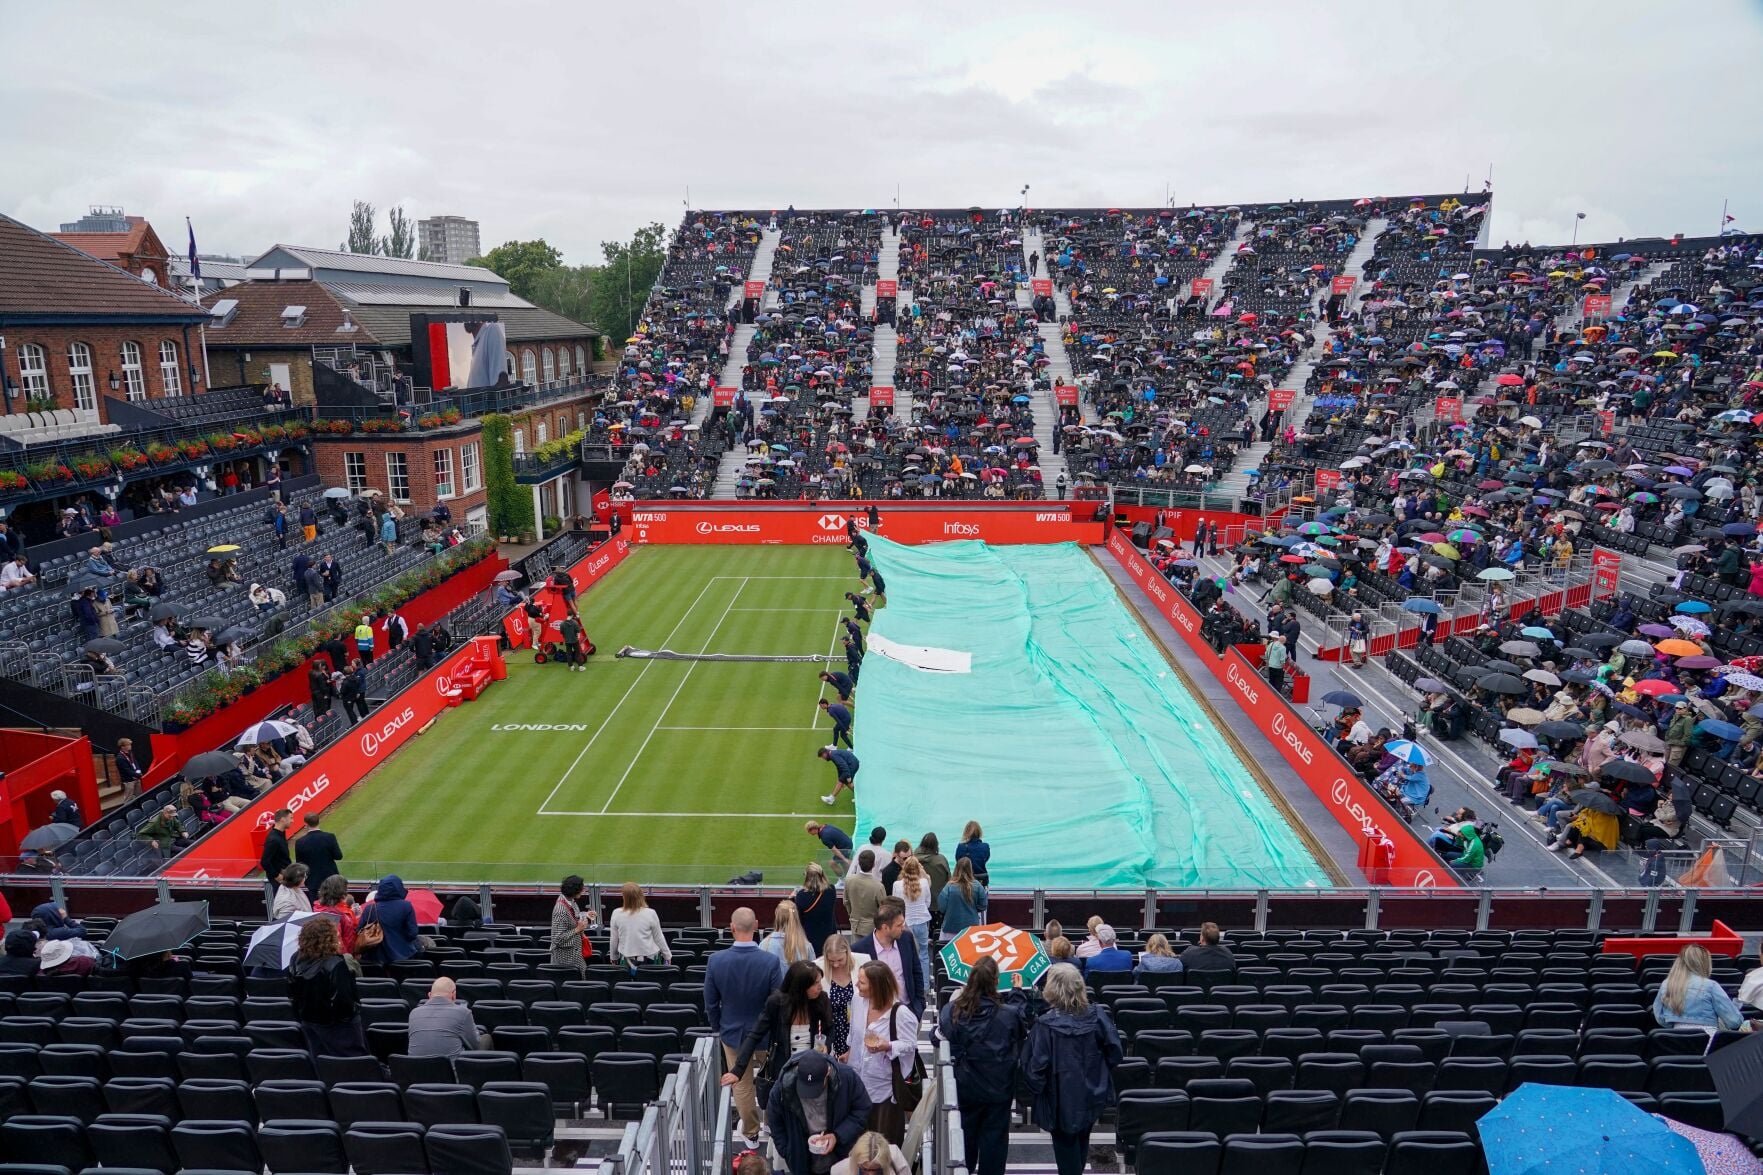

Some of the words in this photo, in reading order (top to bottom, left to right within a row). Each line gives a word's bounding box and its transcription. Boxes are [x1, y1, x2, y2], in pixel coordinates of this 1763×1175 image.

[633, 513, 653, 522] WTA
[654, 513, 667, 522] 500
[1036, 513, 1057, 522] WTA
[1057, 513, 1071, 522] 500
[1168, 511, 1182, 519] PIF
[640, 530, 646, 538] 0
[713, 524, 761, 532] LEXUS
[944, 521, 980, 536] Infosys
[1234, 673, 1259, 705] LEXUS
[375, 707, 415, 742] LEXUS
[1282, 725, 1314, 765] LEXUS
[287, 773, 330, 814] EXUS
[947, 952, 970, 978] ROLAN
